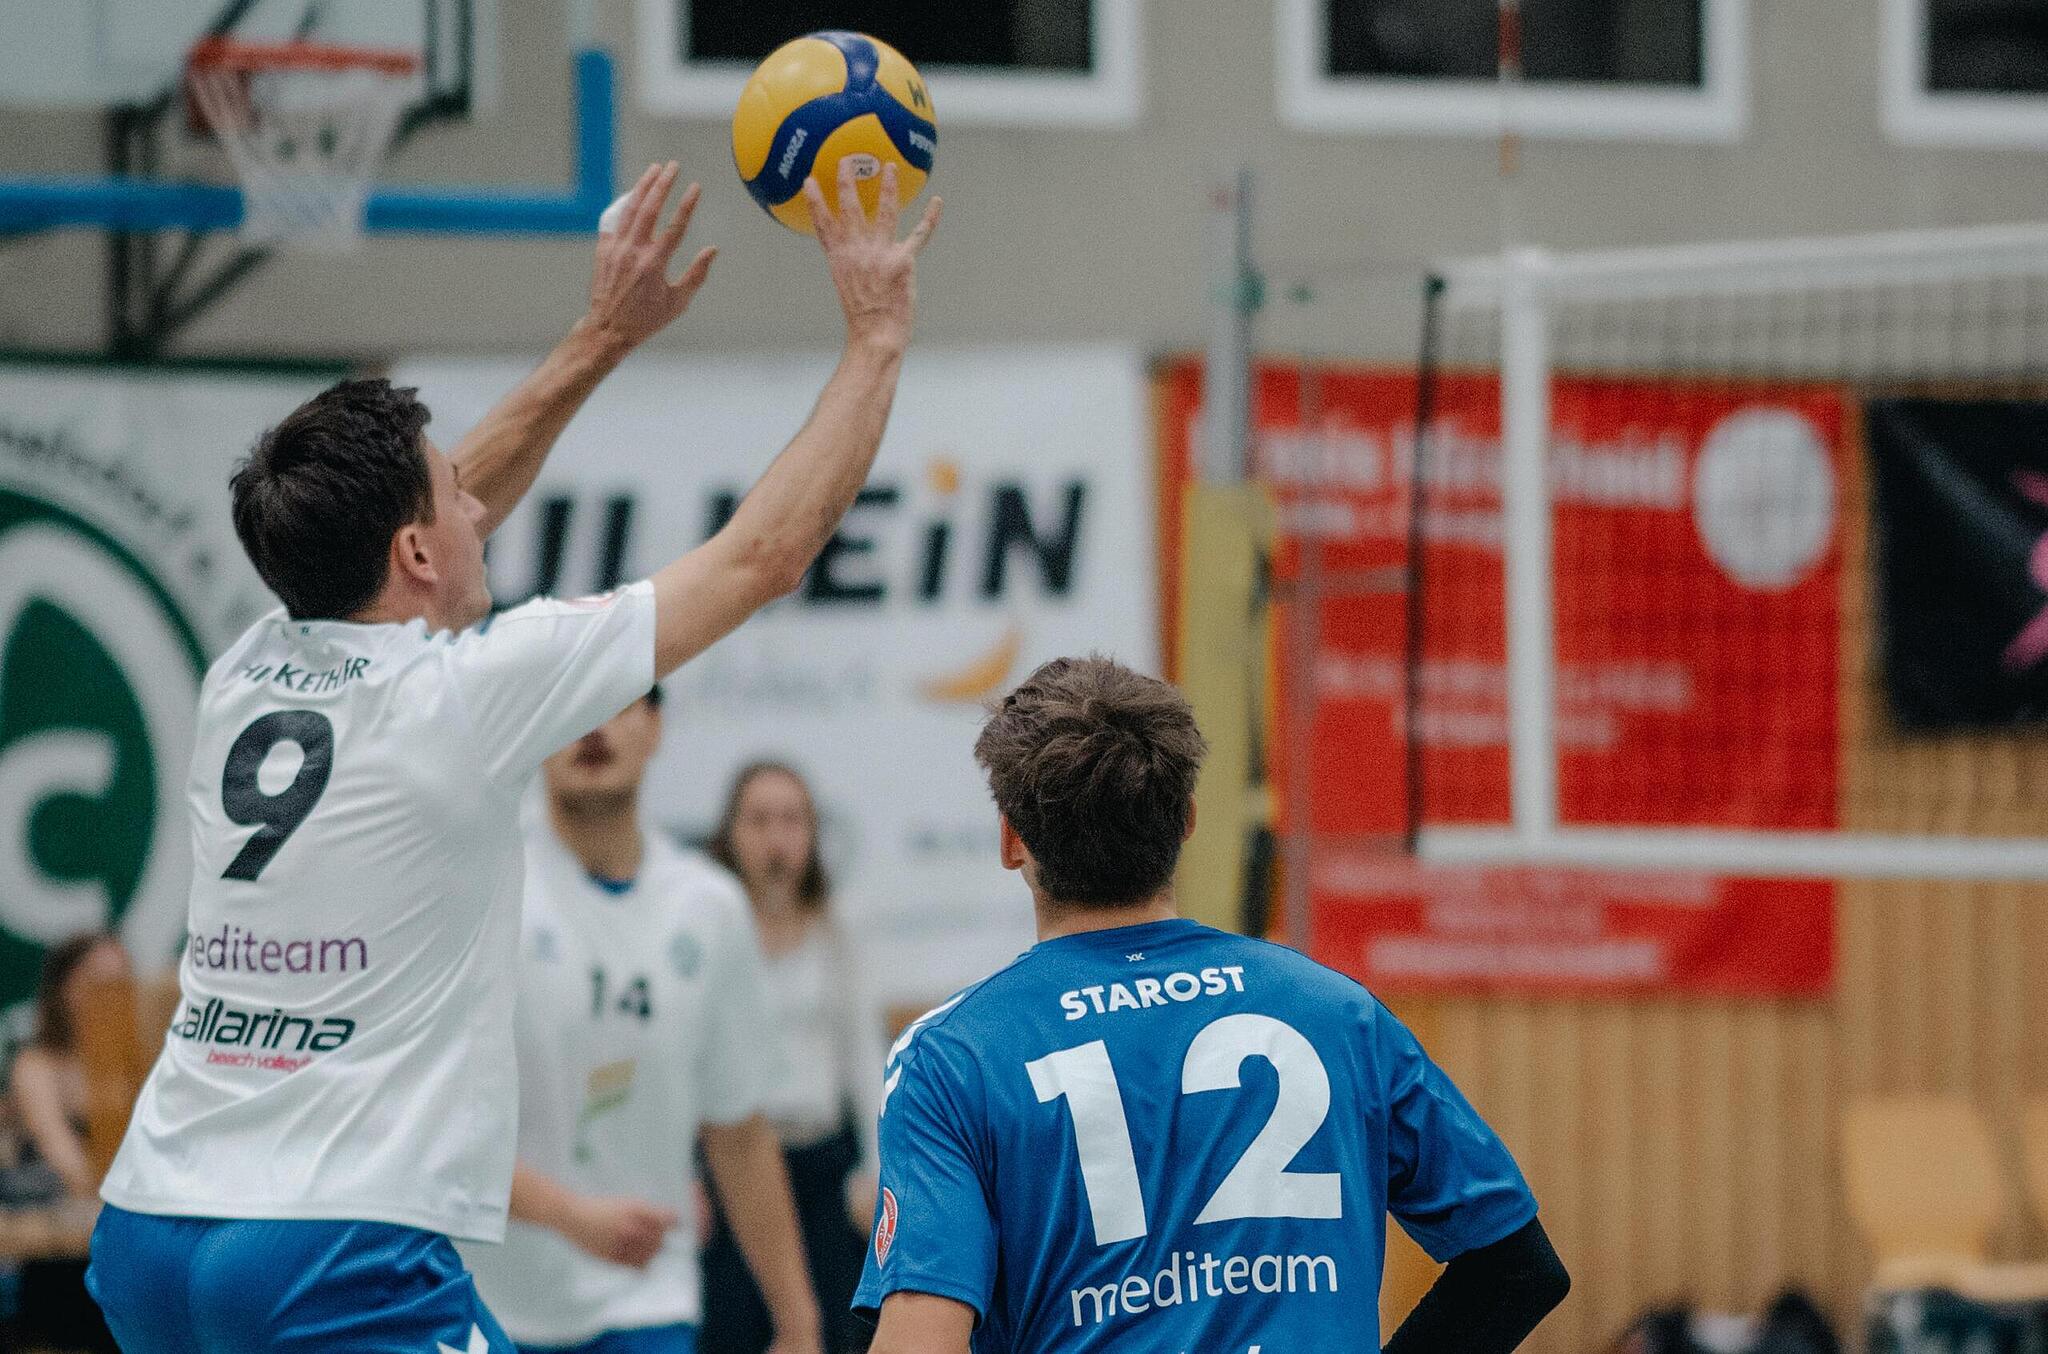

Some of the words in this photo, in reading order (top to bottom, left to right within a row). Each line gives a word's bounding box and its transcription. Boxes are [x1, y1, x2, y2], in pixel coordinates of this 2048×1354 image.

[220, 709, 335, 882] 9
[189, 923, 368, 973] editeam
[590, 963, 653, 1022] 14
[1060, 966, 1245, 1021] STAROST
[1025, 1013, 1343, 1246] 12
[1071, 1251, 1338, 1327] mediteam
